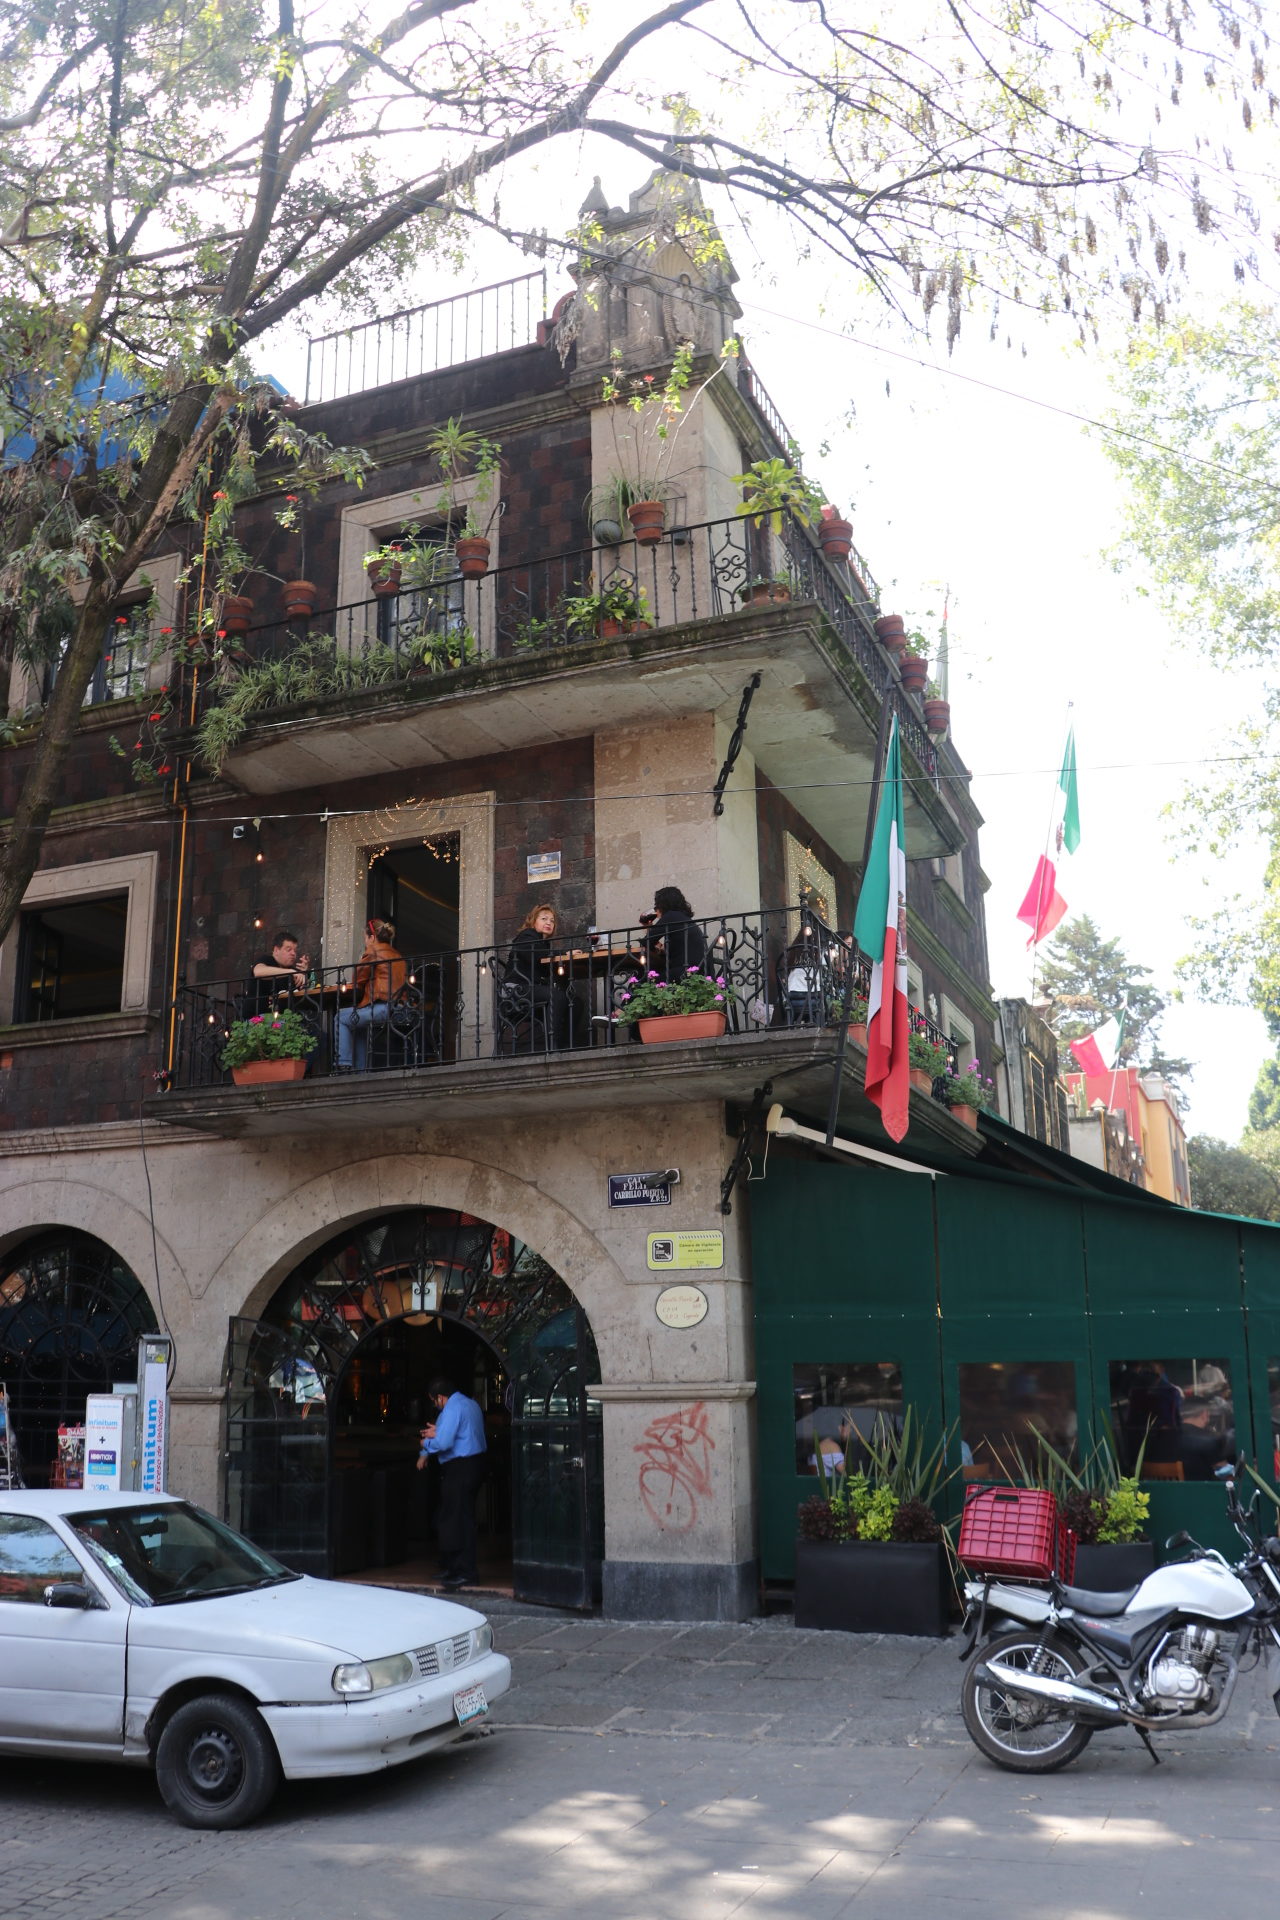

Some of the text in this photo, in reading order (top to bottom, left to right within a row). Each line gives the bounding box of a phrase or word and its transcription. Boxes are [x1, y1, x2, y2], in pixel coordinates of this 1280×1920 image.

[614, 1188, 664, 1199] CARRILLO PUERTO
[157, 1446, 162, 1456] de
